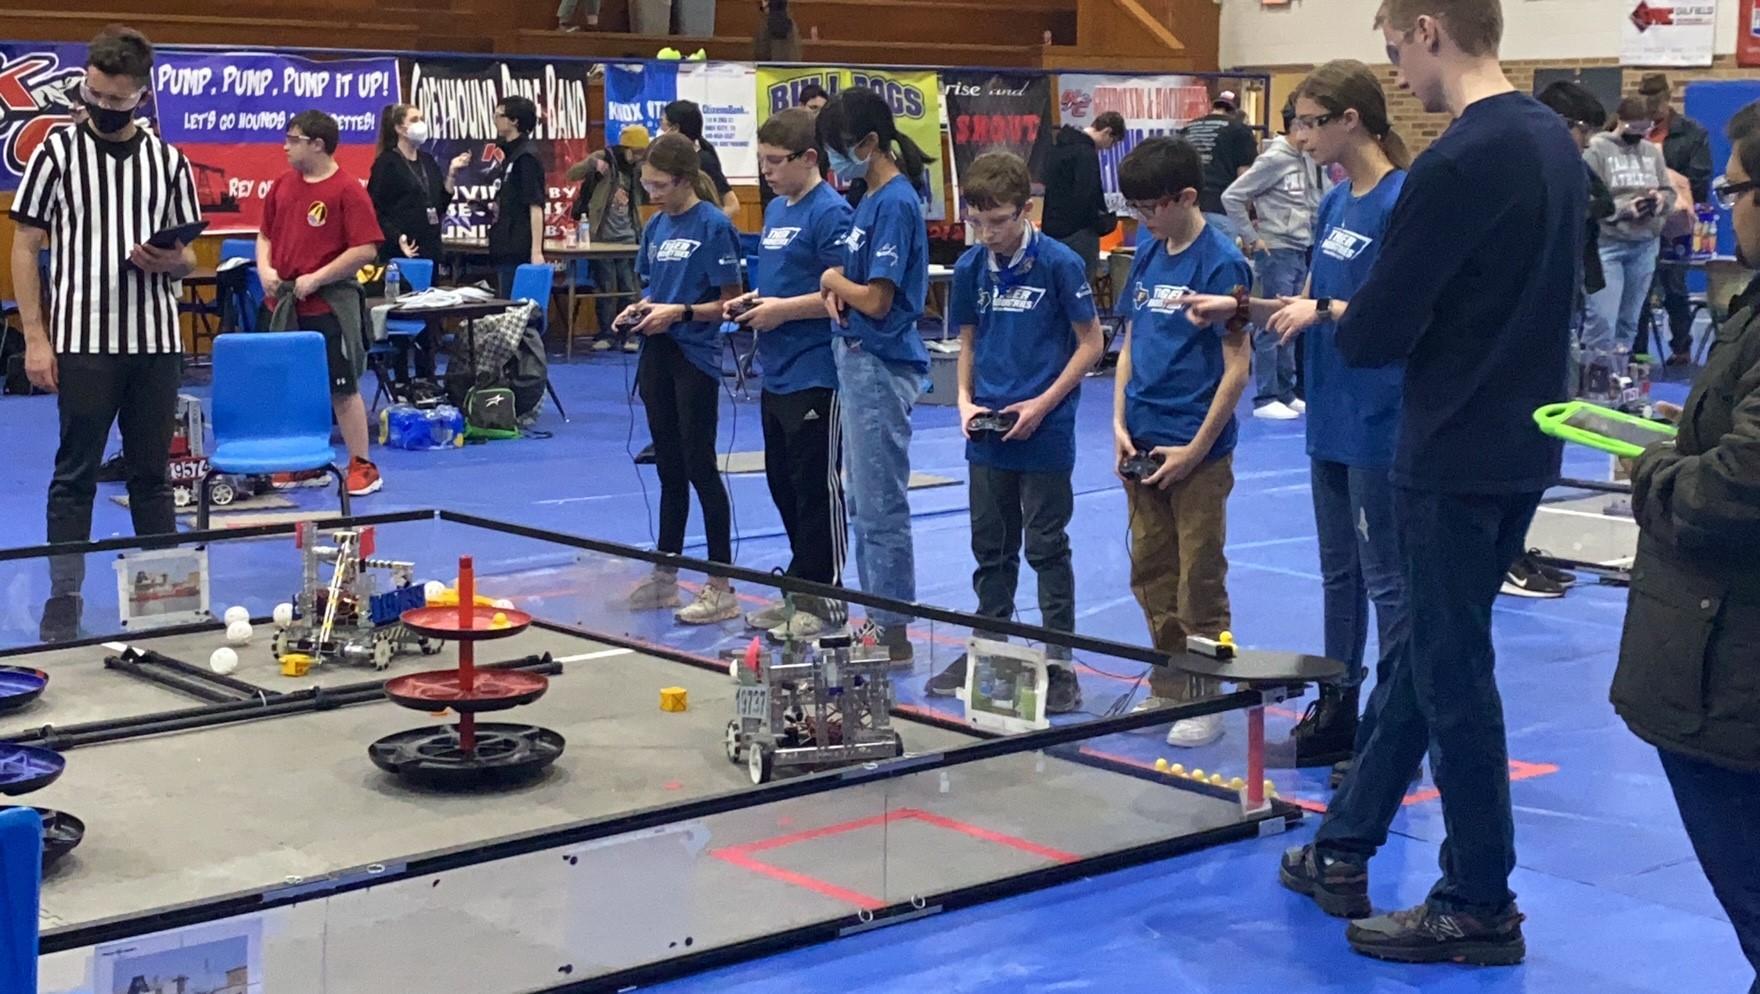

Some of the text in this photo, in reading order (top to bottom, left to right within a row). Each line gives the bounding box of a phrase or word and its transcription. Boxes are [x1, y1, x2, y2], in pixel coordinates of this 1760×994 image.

[283, 67, 330, 97] PUMP
[358, 71, 389, 98] UP!
[944, 80, 1031, 97] rise and
[545, 63, 588, 140] BAND
[219, 112, 235, 130] GO
[237, 111, 286, 130] HOUNDS
